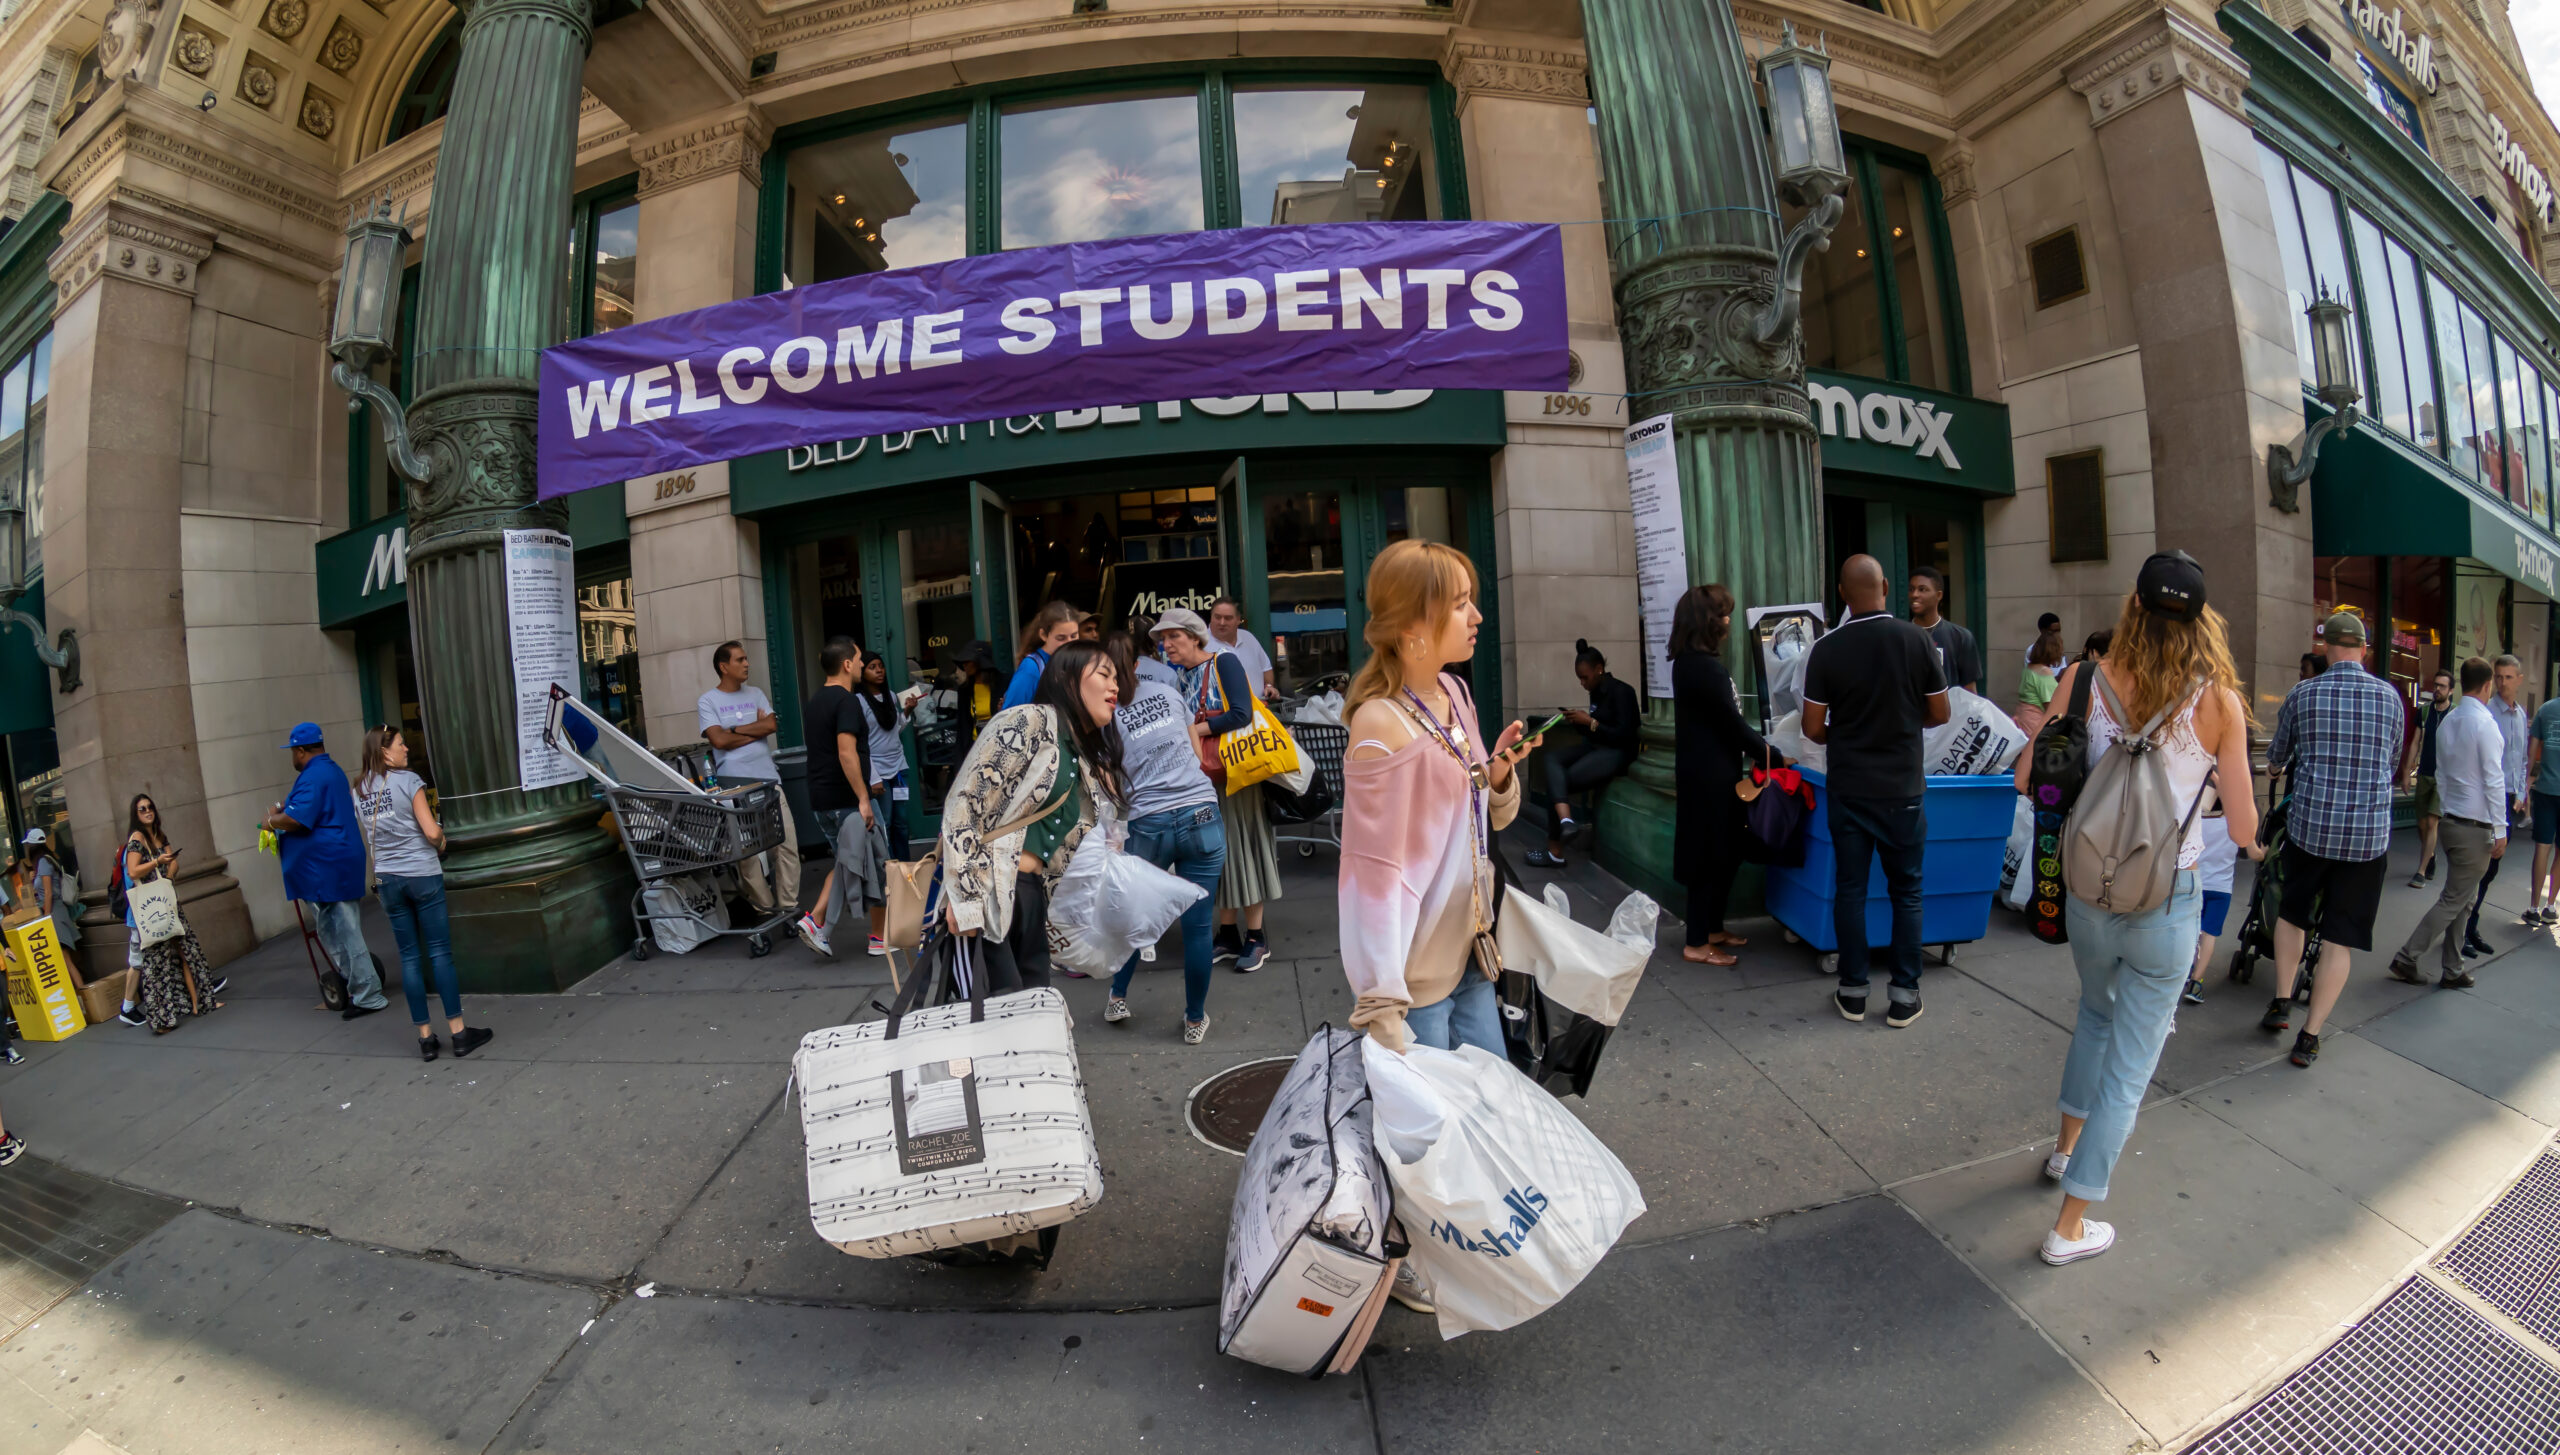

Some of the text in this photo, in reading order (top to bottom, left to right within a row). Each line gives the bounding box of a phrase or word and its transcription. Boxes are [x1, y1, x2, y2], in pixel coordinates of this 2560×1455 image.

[566, 267, 1524, 440] WELCOME STUDENTS
[1542, 394, 1592, 417] 1996
[1629, 422, 1666, 442] BEYOND
[654, 471, 697, 501] 1896
[510, 534, 523, 544] BED
[524, 535, 539, 544] BATH
[544, 535, 571, 548] BEYOND
[1294, 603, 1317, 615] 620
[927, 635, 949, 648] 620
[1117, 693, 1166, 718] GETTING
[1121, 700, 1170, 725] CAMPUS
[1126, 709, 1171, 733] READY?
[1135, 726, 1153, 739] CAN
[1152, 718, 1175, 733] HELP!
[1253, 710, 1271, 729] A
[1220, 730, 1287, 767] HIPPEA
[1941, 716, 1982, 771] BATH &
[140, 895, 168, 911] HAWAII
[140, 910, 176, 938] SAN SEBASTIAN
[27, 927, 76, 1033] I'M A HIPPEA
[908, 1136, 949, 1151] RACHEL
[951, 1131, 972, 1144] ZOE
[907, 1154, 941, 1164] TWIN/TWIN
[917, 1157, 955, 1168] COMFORTER
